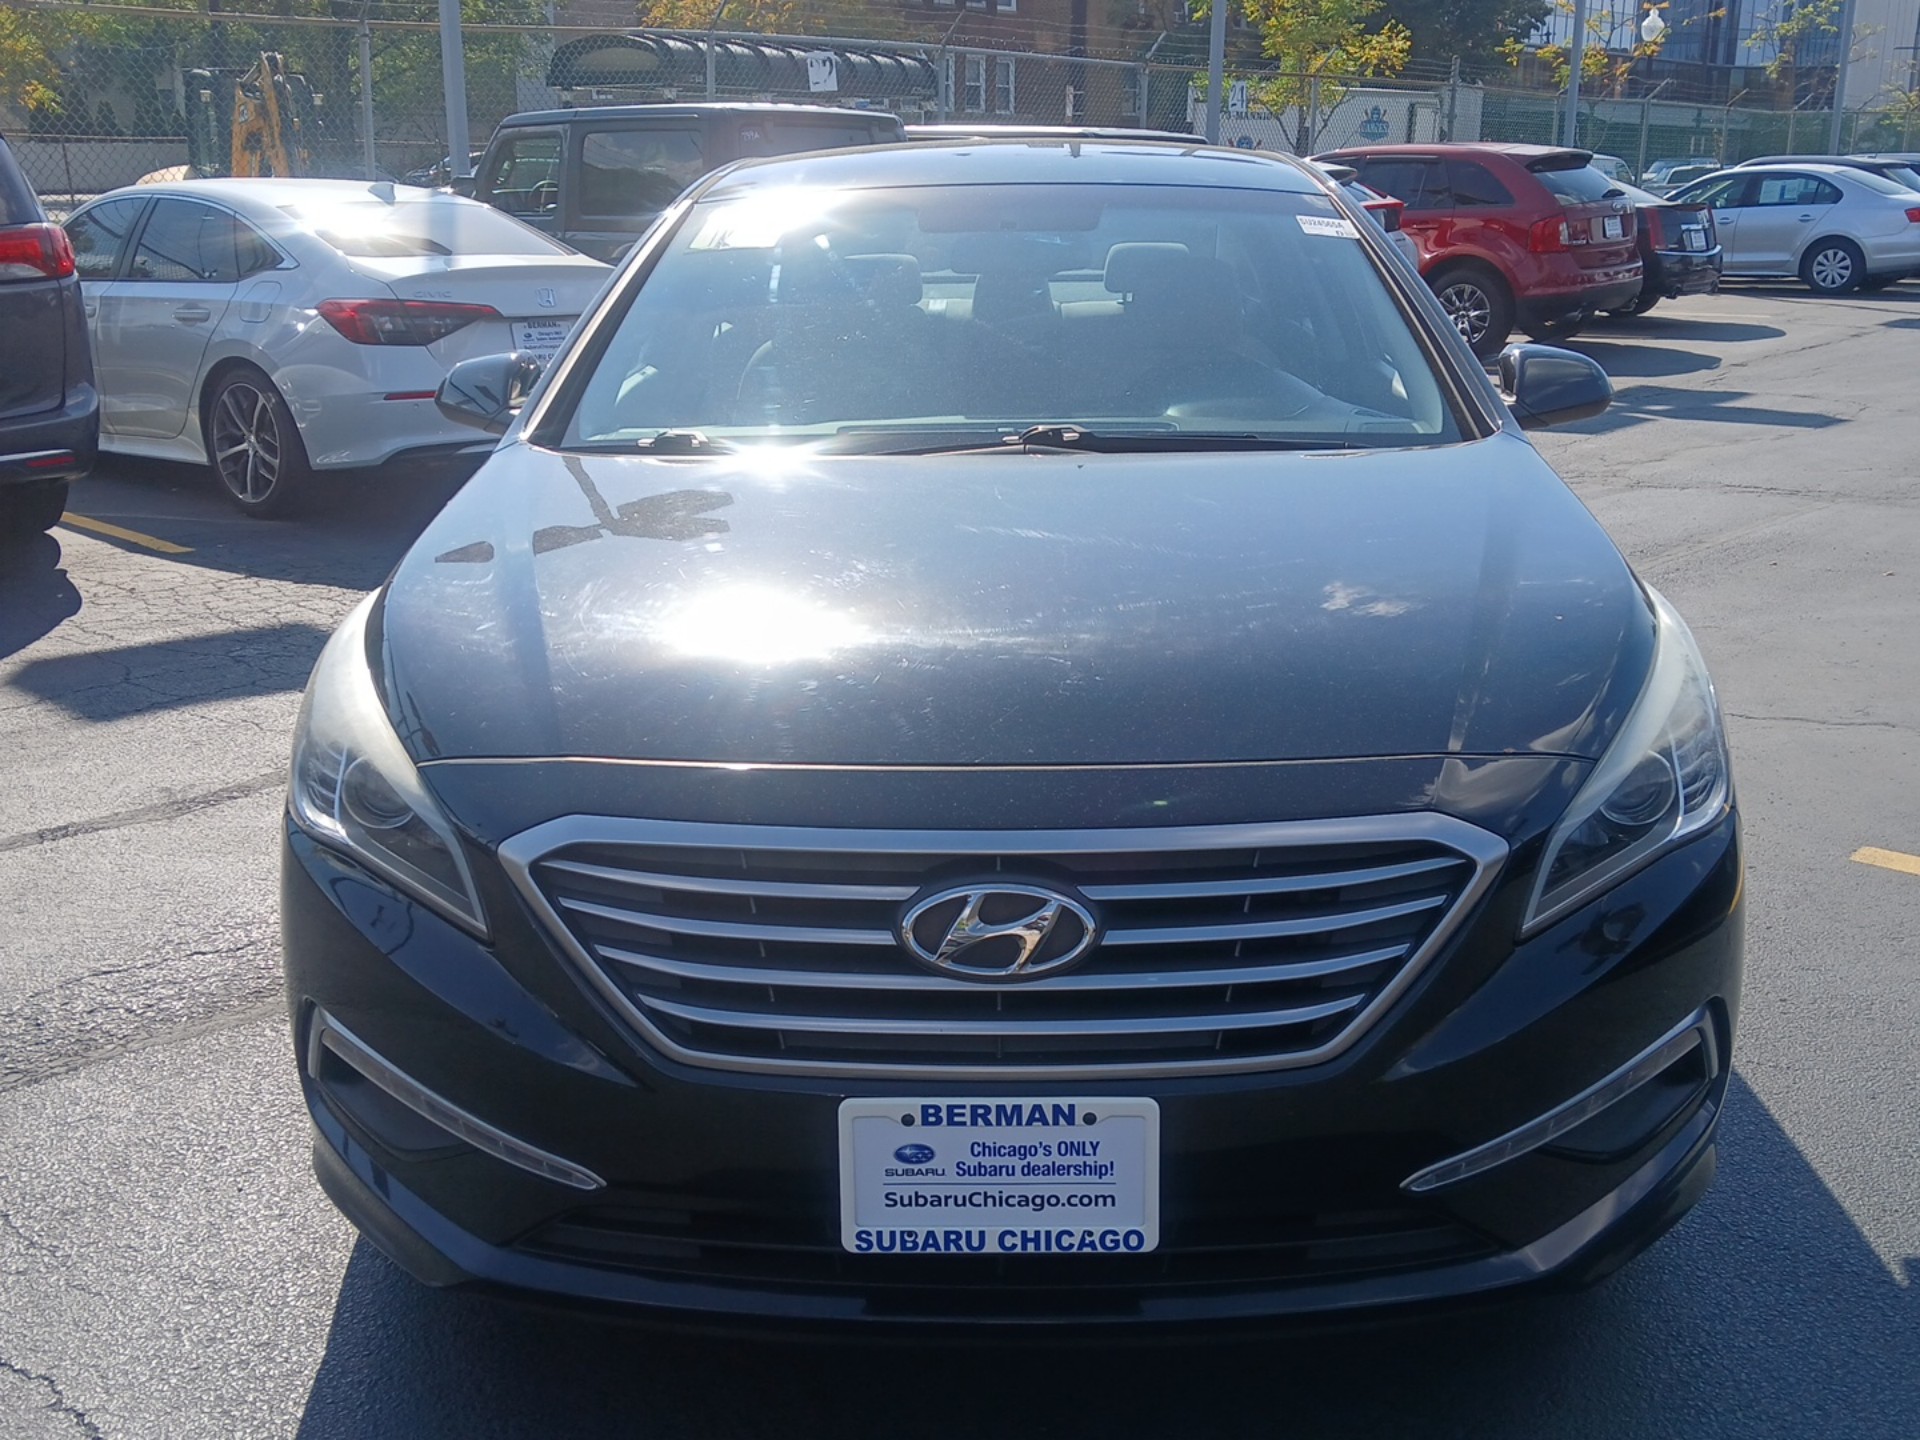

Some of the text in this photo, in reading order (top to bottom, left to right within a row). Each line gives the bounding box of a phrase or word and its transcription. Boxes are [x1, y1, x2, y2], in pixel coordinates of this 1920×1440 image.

[920, 1103, 1077, 1127] BERMAN
[970, 1141, 1101, 1161] Chicago's ONLY
[884, 1167, 946, 1177] SUBARU
[955, 1160, 1115, 1180] Subaru dealership!
[884, 1190, 1116, 1212] SubaruChicago.com
[855, 1229, 1146, 1252] SUBARU CHICAGO
